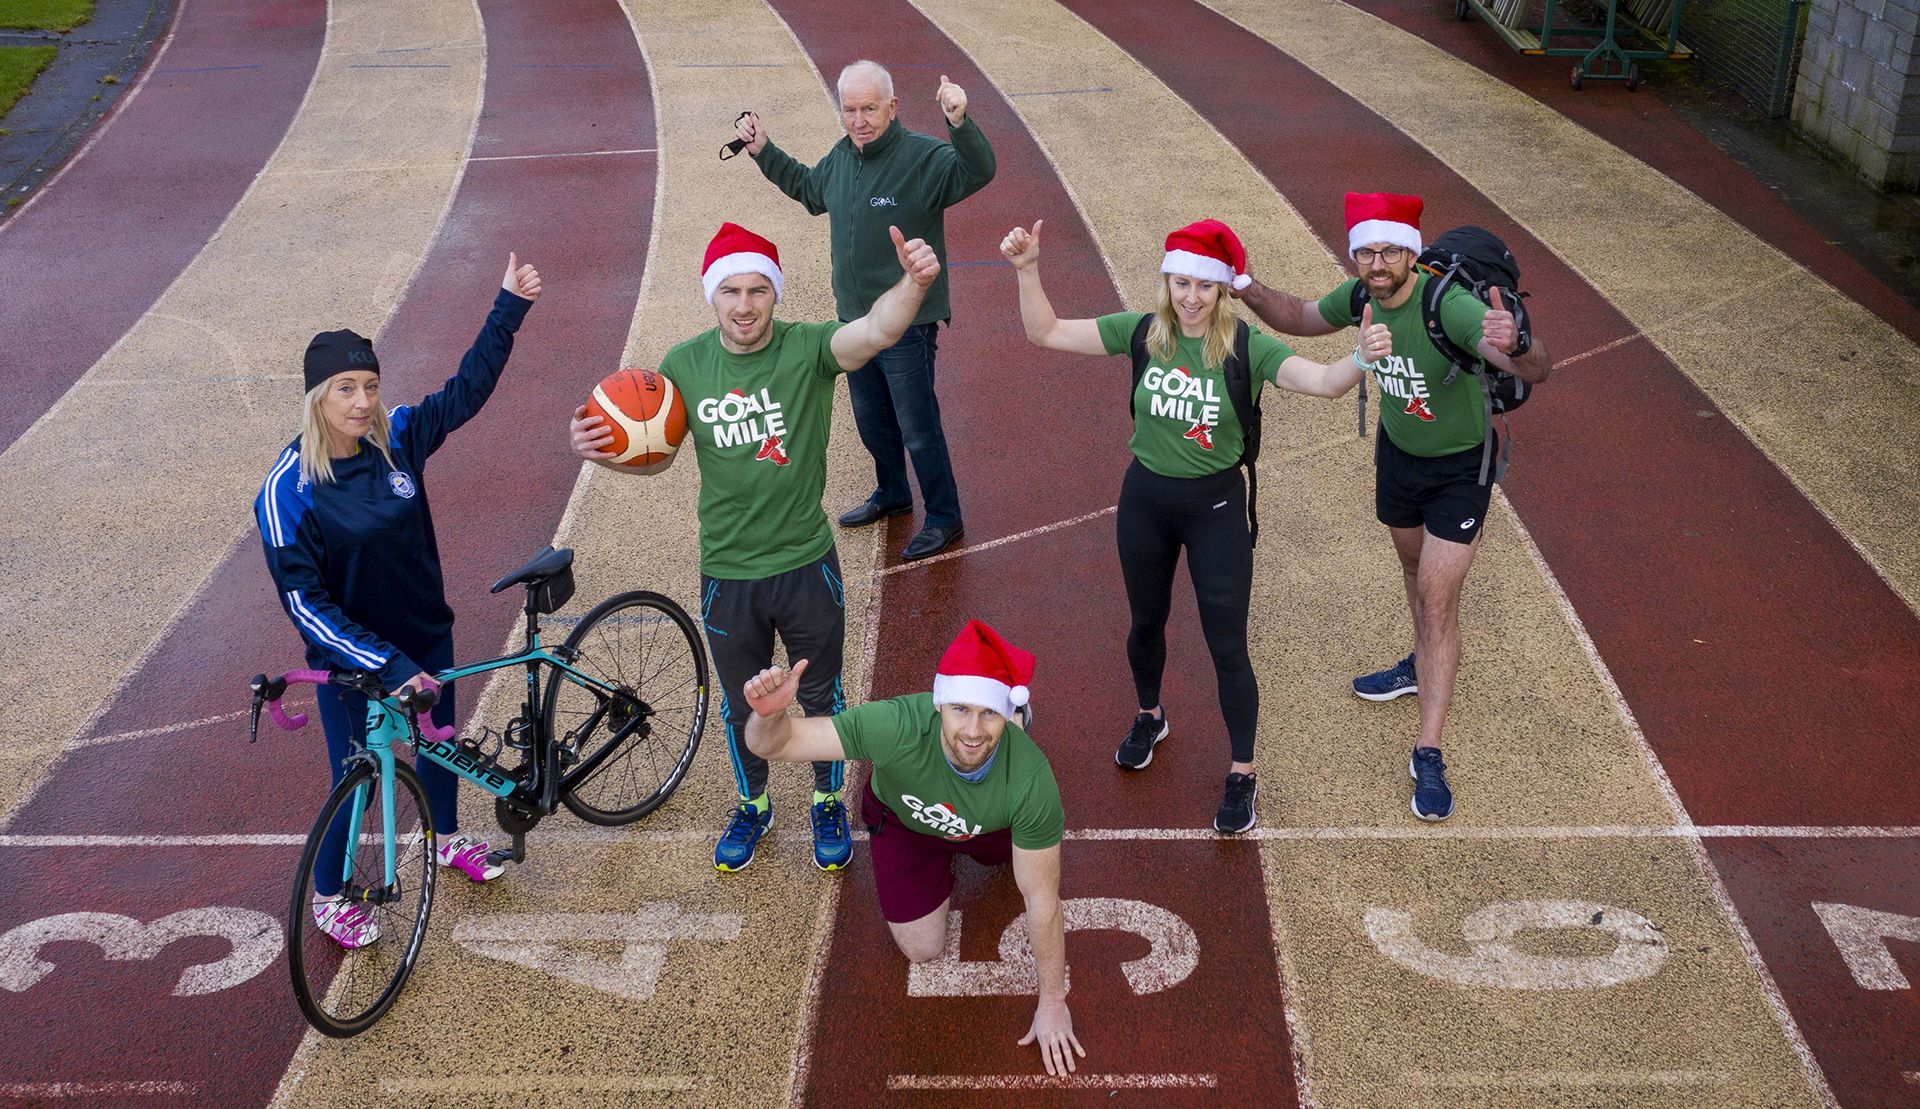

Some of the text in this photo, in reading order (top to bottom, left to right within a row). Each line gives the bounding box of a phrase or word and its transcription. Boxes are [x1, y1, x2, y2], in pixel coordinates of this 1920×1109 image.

[869, 196, 898, 207] GOAL
[1374, 354, 1425, 378] OAL
[1143, 366, 1221, 403] GOAL
[1375, 372, 1431, 399] MILE
[697, 388, 782, 423] GOAL
[1150, 394, 1220, 427] MILE
[713, 412, 788, 448] MILE
[407, 734, 505, 790] apierre
[911, 811, 971, 837] MIL
[0, 906, 285, 997] 3
[451, 901, 743, 1001] 4
[906, 897, 1200, 998] 5
[1363, 899, 1669, 991] 6
